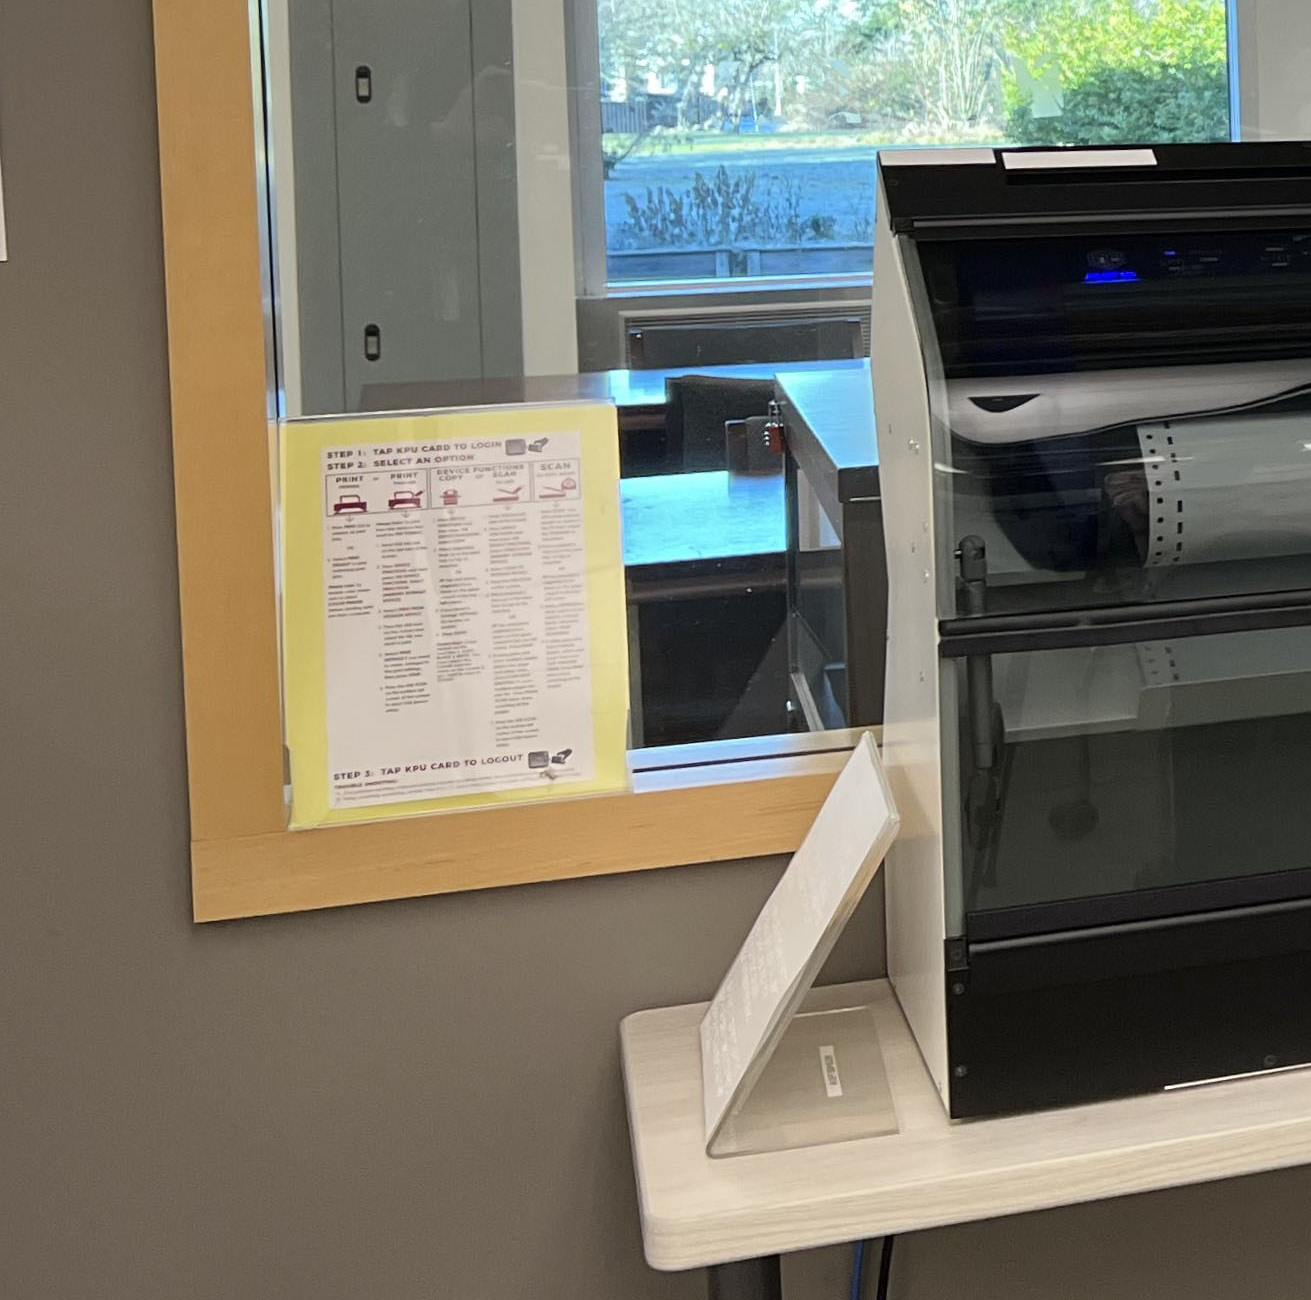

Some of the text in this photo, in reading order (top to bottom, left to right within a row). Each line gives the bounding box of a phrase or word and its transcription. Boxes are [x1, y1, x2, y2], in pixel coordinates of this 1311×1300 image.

[327, 450, 353, 458] STEP
[396, 446, 418, 454] KPU
[327, 462, 353, 470] STEP
[374, 458, 412, 466] SELECT
[334, 772, 360, 781] STEP
[380, 767, 401, 776] TAP
[405, 764, 427, 773] KPU
[430, 760, 460, 770] CARD
[465, 759, 477, 767] TO
